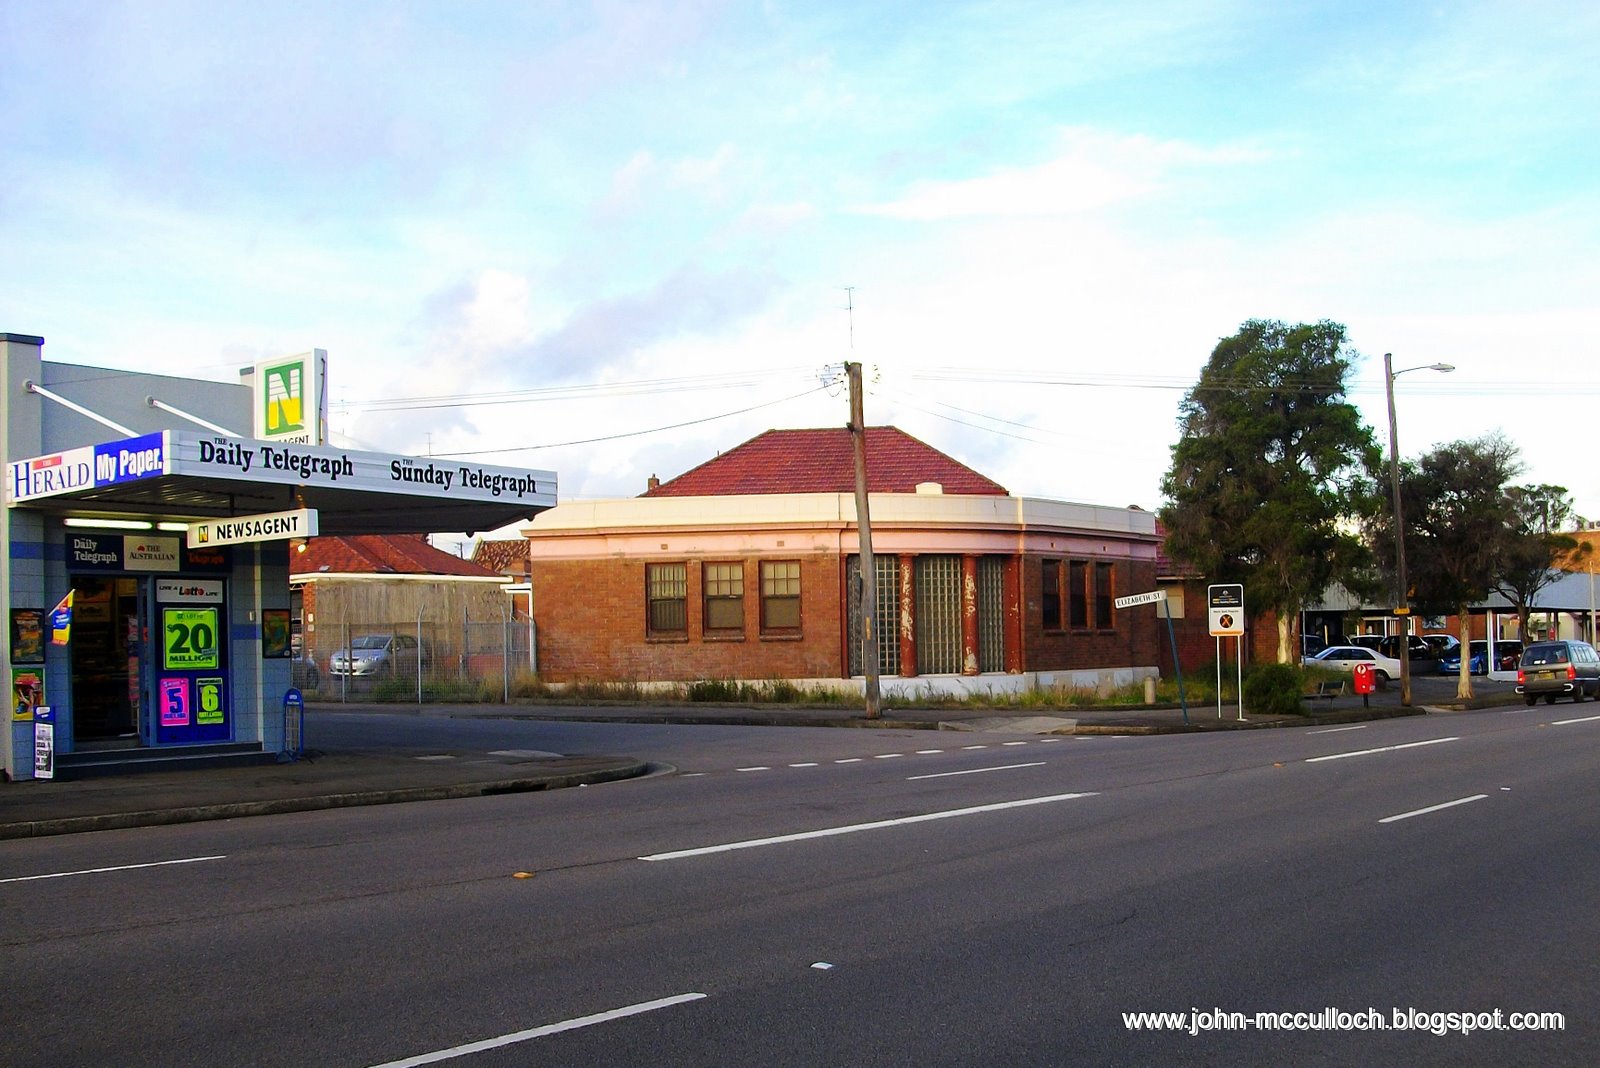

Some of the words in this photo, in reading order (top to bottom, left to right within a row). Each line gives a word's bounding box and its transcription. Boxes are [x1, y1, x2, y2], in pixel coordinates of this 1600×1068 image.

[214, 437, 227, 445] THE
[96, 453, 117, 481] My
[119, 448, 162, 477] Paper.
[199, 440, 253, 472] Daily
[261, 447, 354, 480] Telegraph
[390, 460, 453, 490] Sunday
[459, 467, 537, 497] Telegraph
[216, 516, 299, 540] NEWSAGENT
[74, 539, 97, 551] Daily
[74, 550, 117, 564] Telegraph
[1117, 595, 1151, 607] ELIZABETH
[1153, 592, 1161, 600] ST
